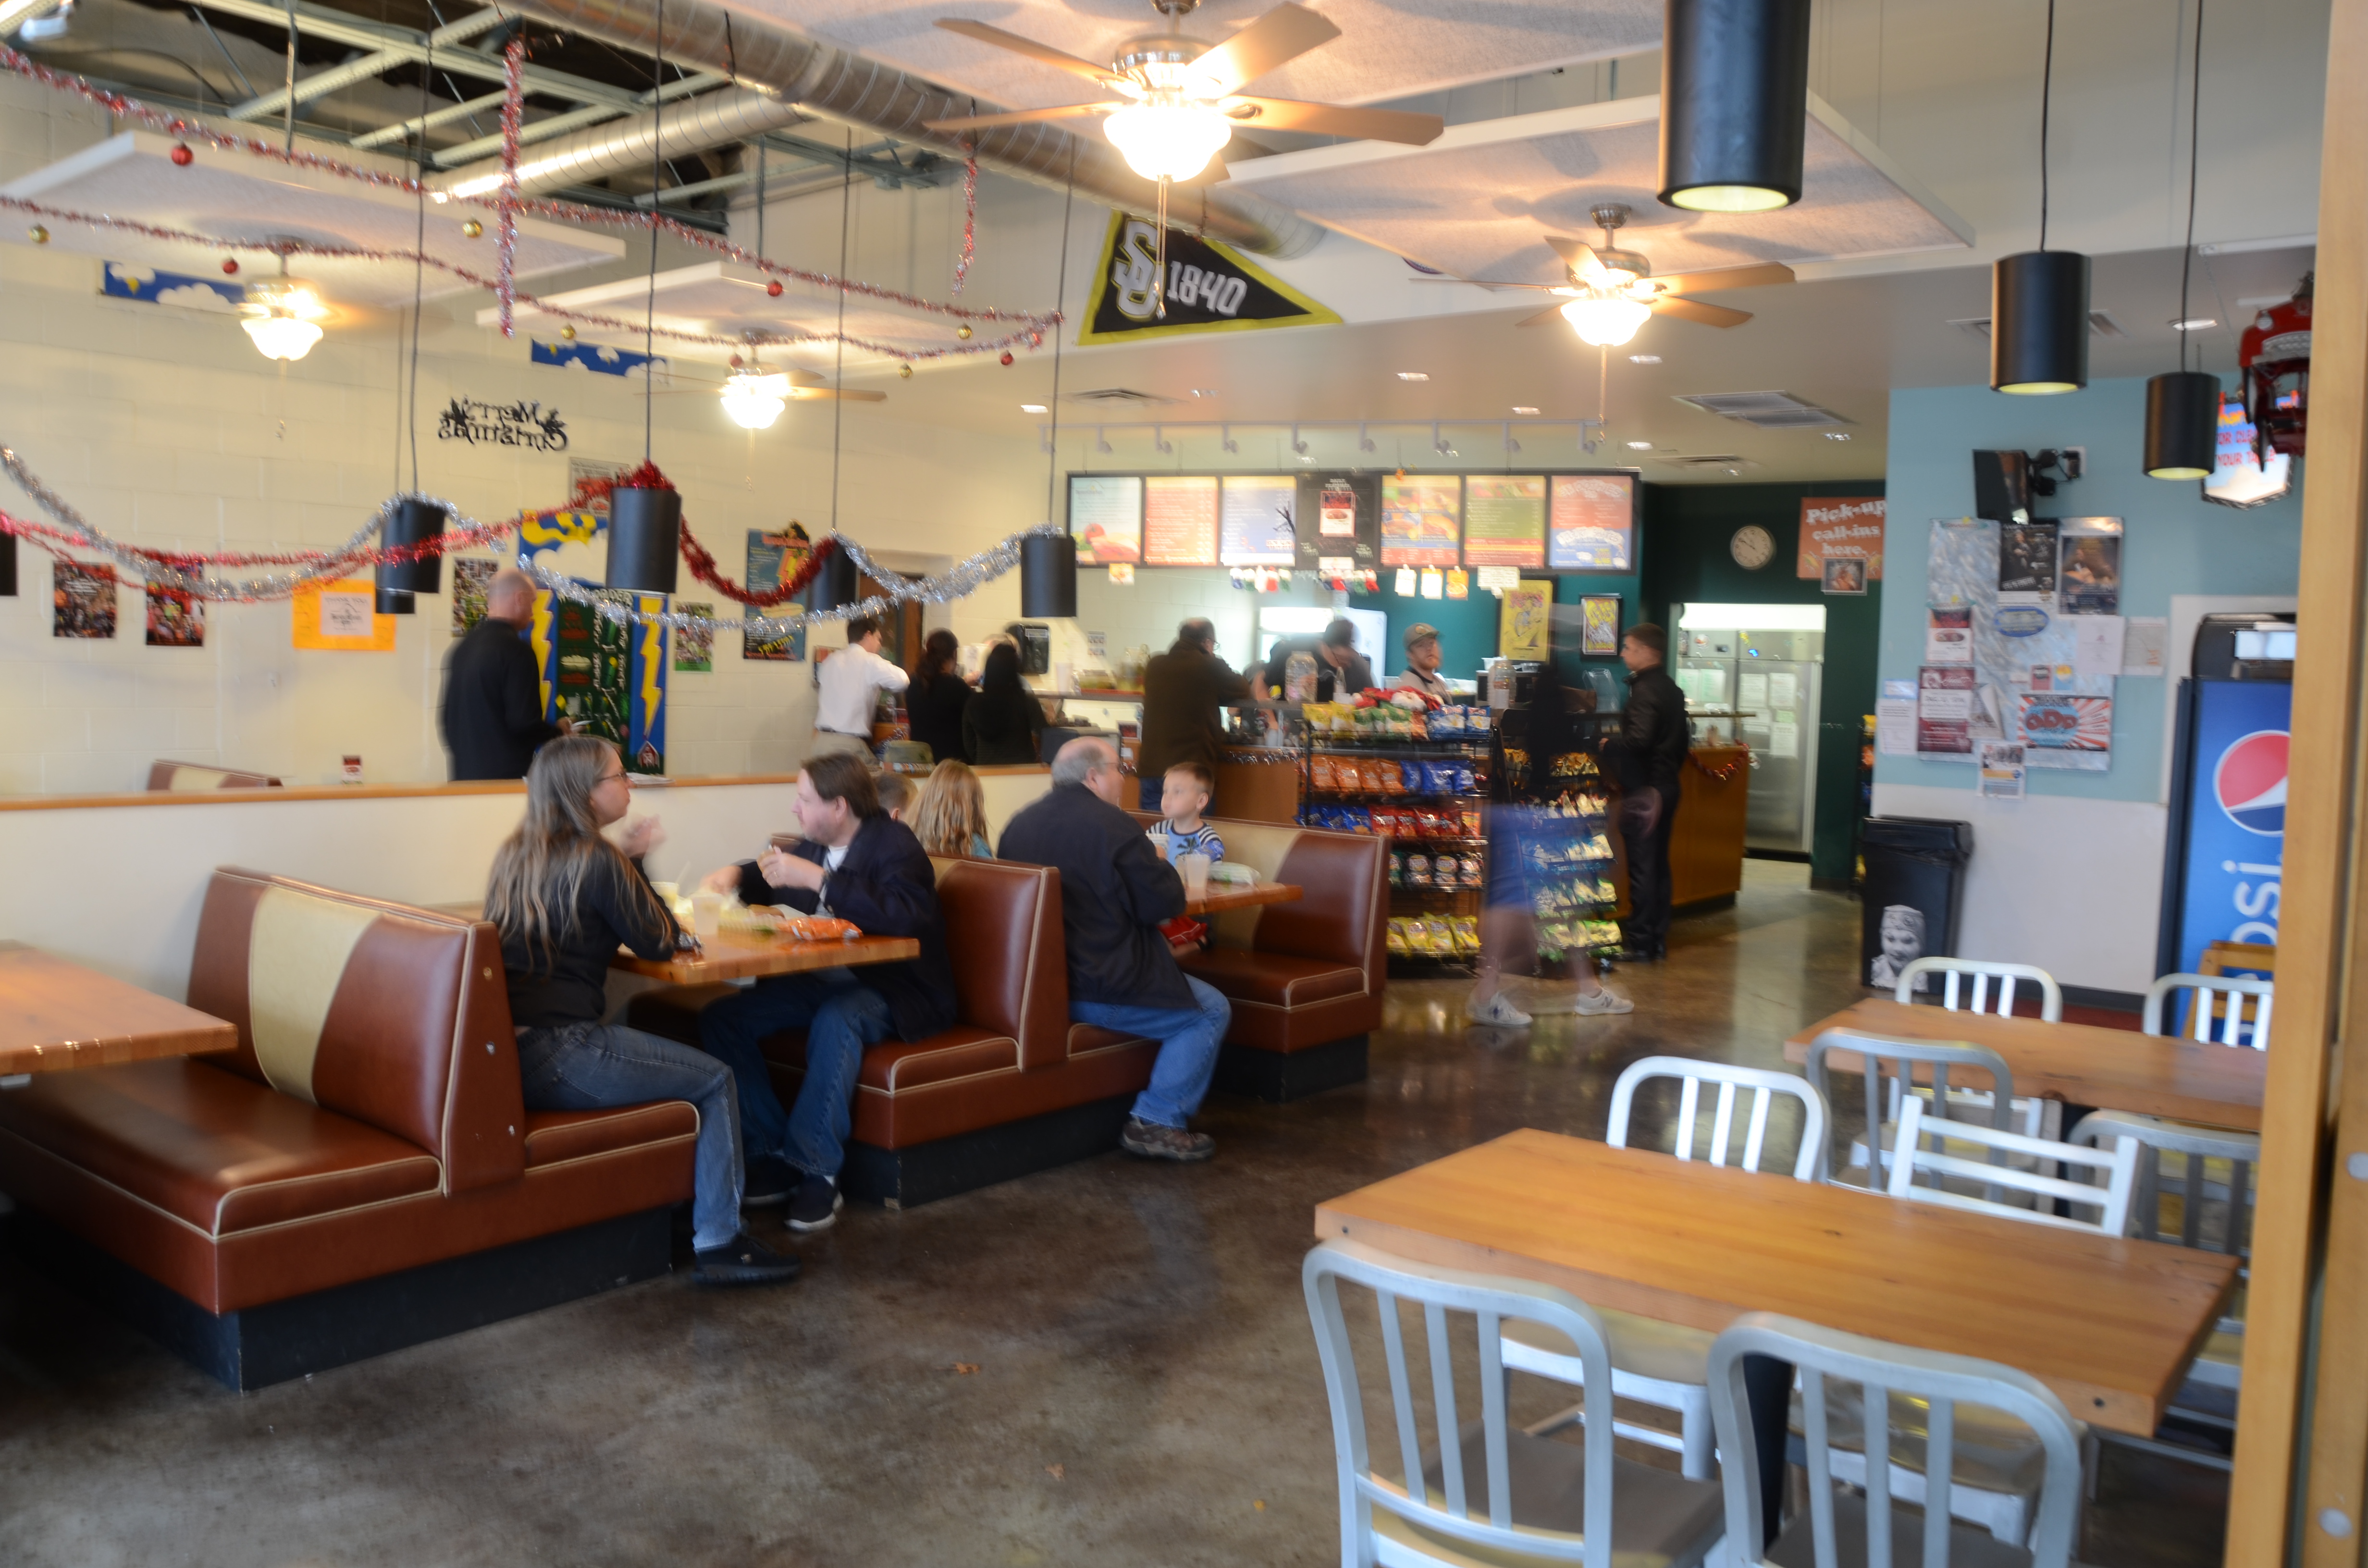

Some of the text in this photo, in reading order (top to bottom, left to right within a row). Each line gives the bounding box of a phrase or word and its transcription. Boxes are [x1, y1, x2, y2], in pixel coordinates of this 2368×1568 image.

[1167, 260, 1248, 317] 1840
[2216, 431, 2232, 445] OR
[1806, 500, 1885, 525] Pick-up
[1812, 524, 1881, 542] call-ins
